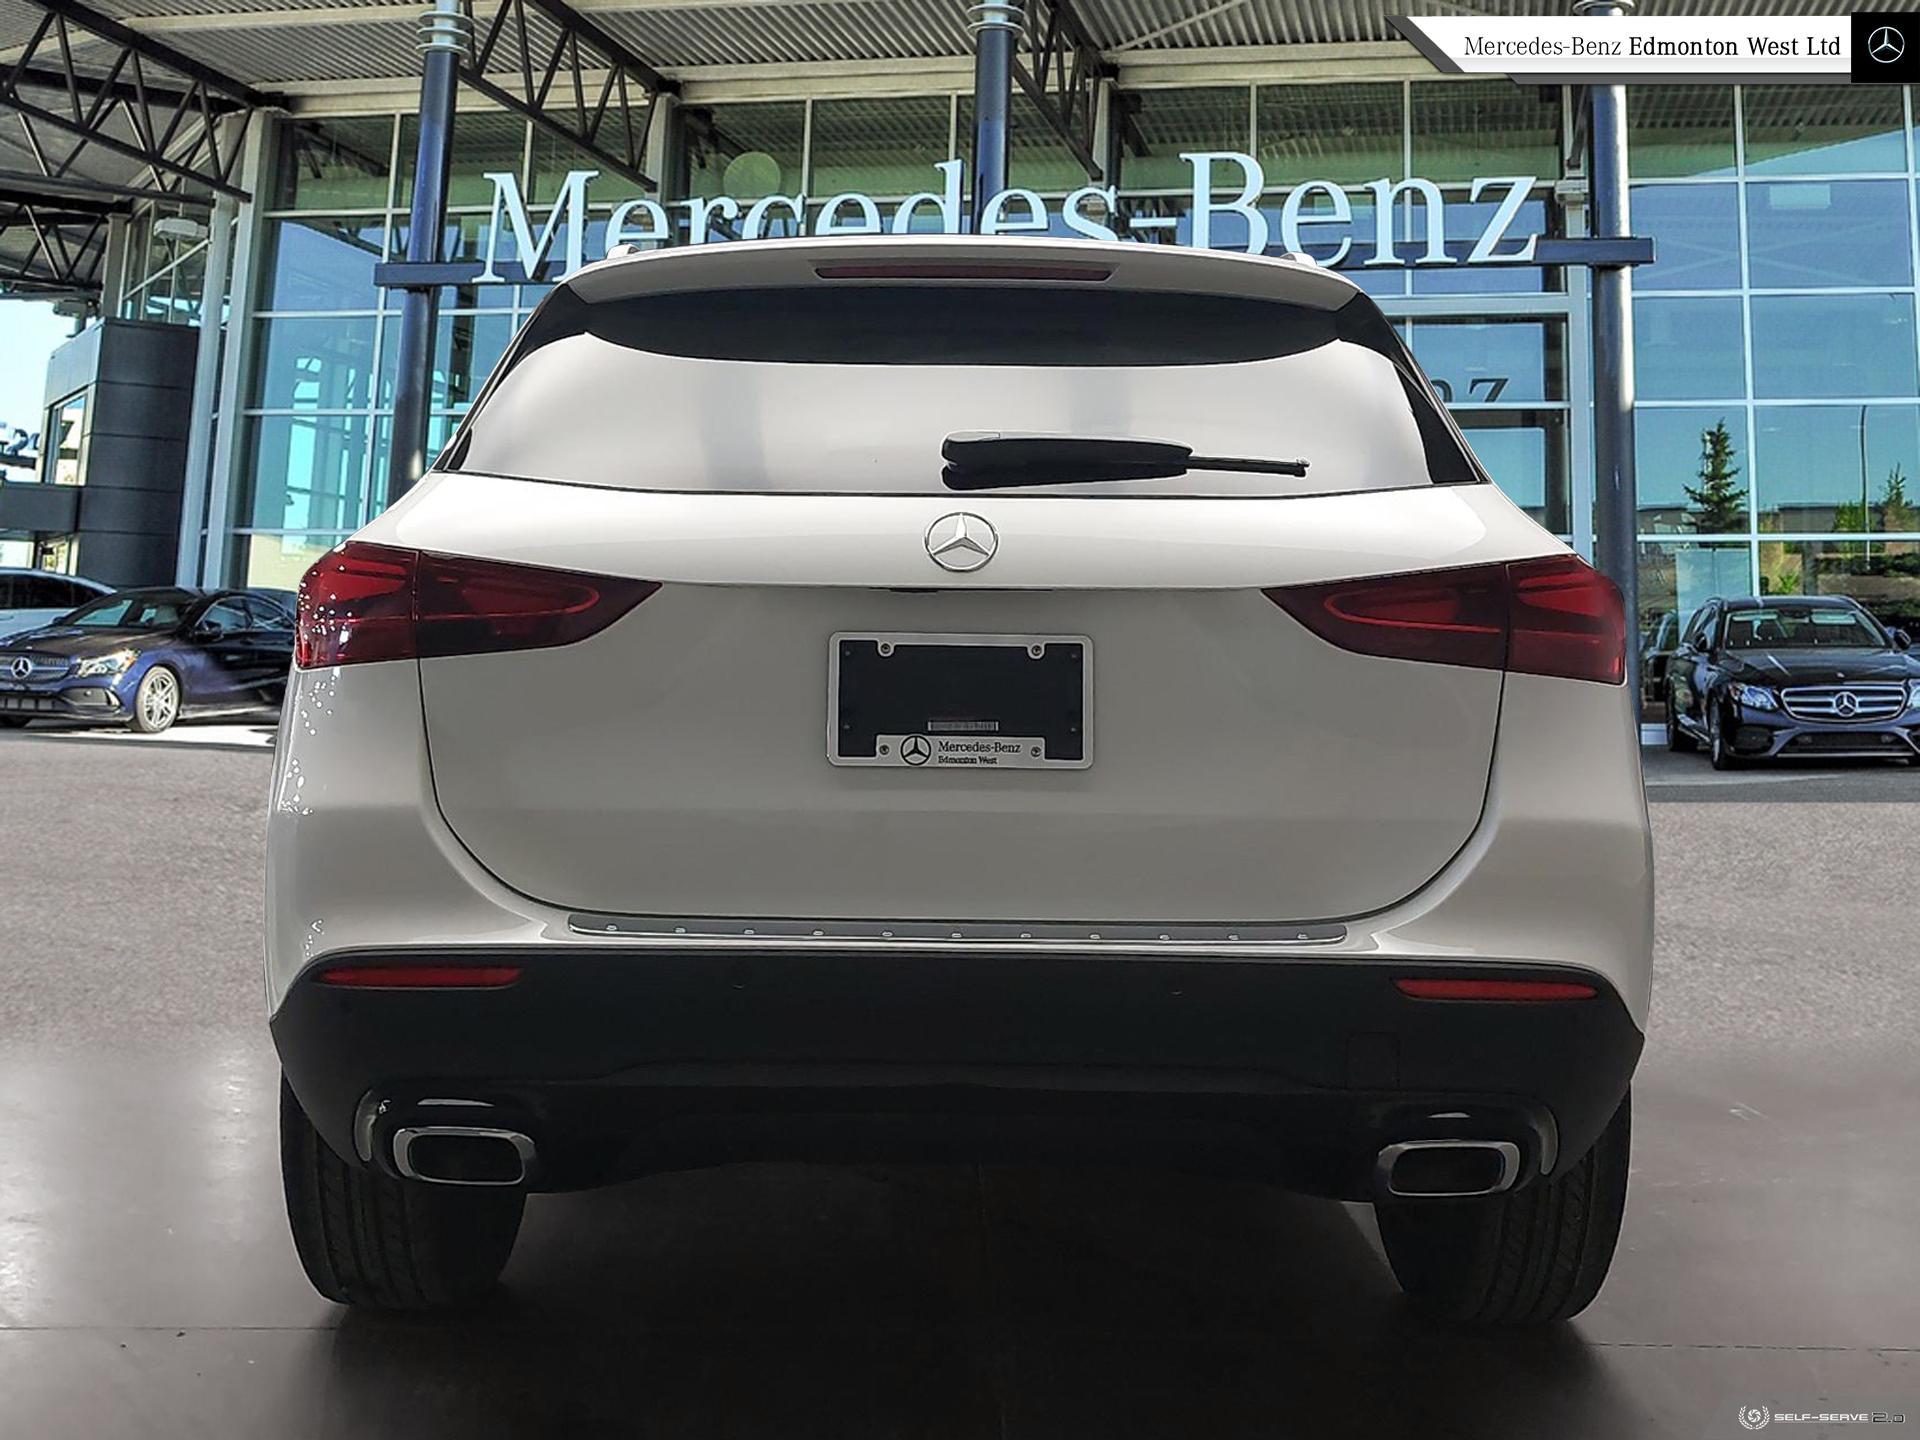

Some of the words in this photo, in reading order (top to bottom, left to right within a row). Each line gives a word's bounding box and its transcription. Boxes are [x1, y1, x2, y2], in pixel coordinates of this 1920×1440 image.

[471, 150, 1538, 283] Mercedes-Benz
[938, 740, 1021, 753] Mercedes-Benz
[938, 755, 976, 765] Edmonton
[978, 755, 998, 765] West
